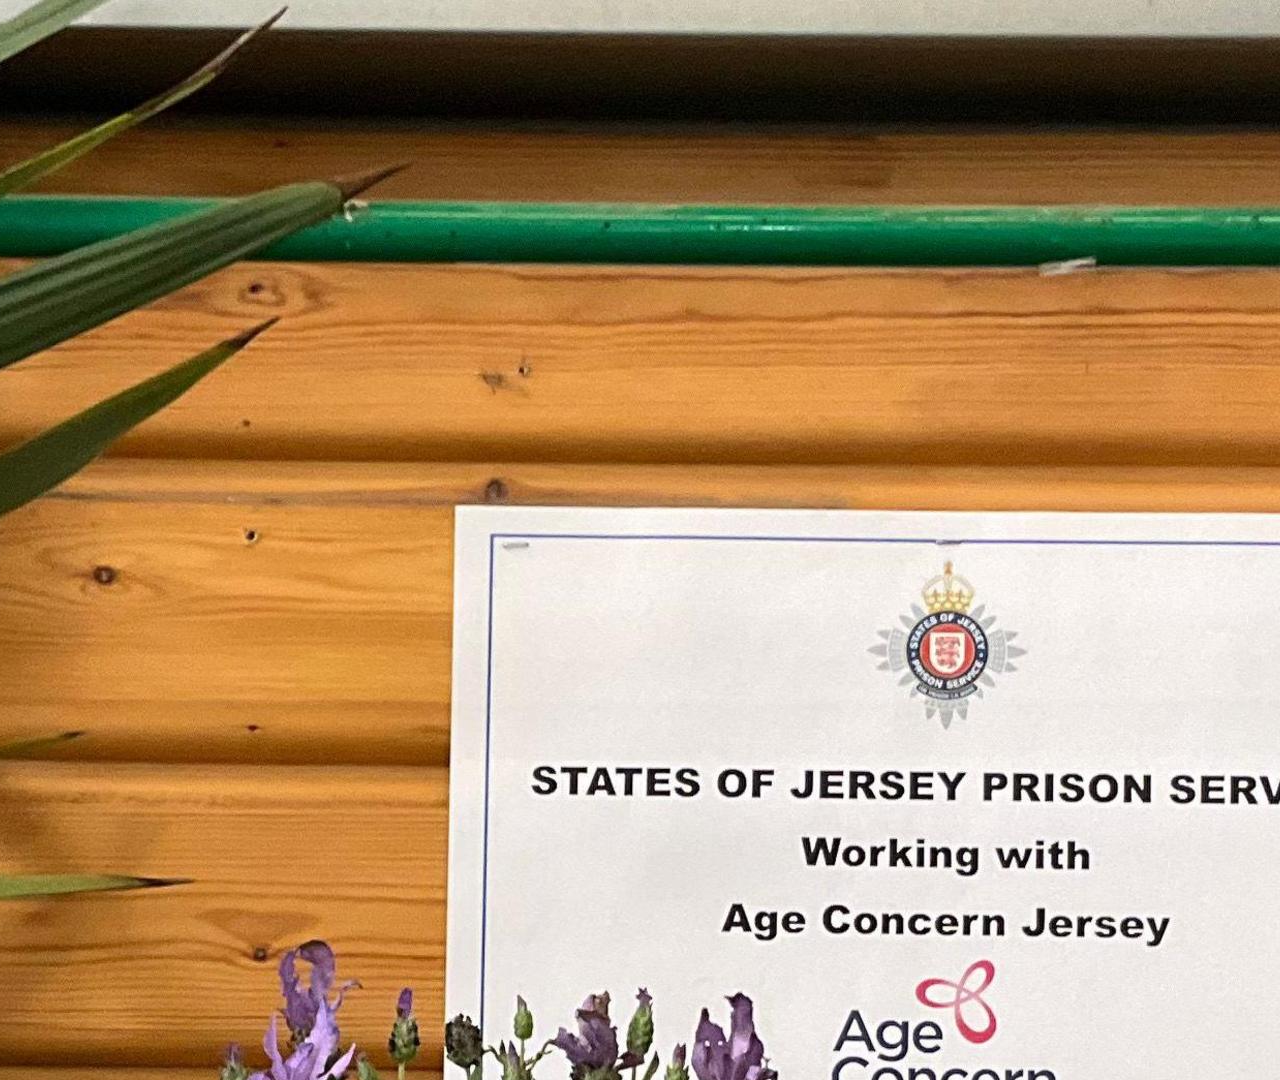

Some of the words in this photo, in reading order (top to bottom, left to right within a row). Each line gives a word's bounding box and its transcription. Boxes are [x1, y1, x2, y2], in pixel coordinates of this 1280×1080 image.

[910, 616, 938, 650] STATES
[940, 613, 955, 622] OF
[957, 616, 986, 650] JERSEY
[912, 659, 944, 689] PRISON
[946, 660, 985, 689] SERVICE
[531, 766, 701, 798] STATES
[717, 768, 775, 798] OF
[790, 770, 966, 801] JERSEY
[983, 772, 1152, 803] PRISON
[801, 836, 979, 877] Working
[995, 840, 1090, 870] with
[722, 903, 806, 941] Age
[822, 904, 1005, 937] Concern
[1022, 907, 1170, 947] Jersey
[832, 1009, 943, 1062] Age
